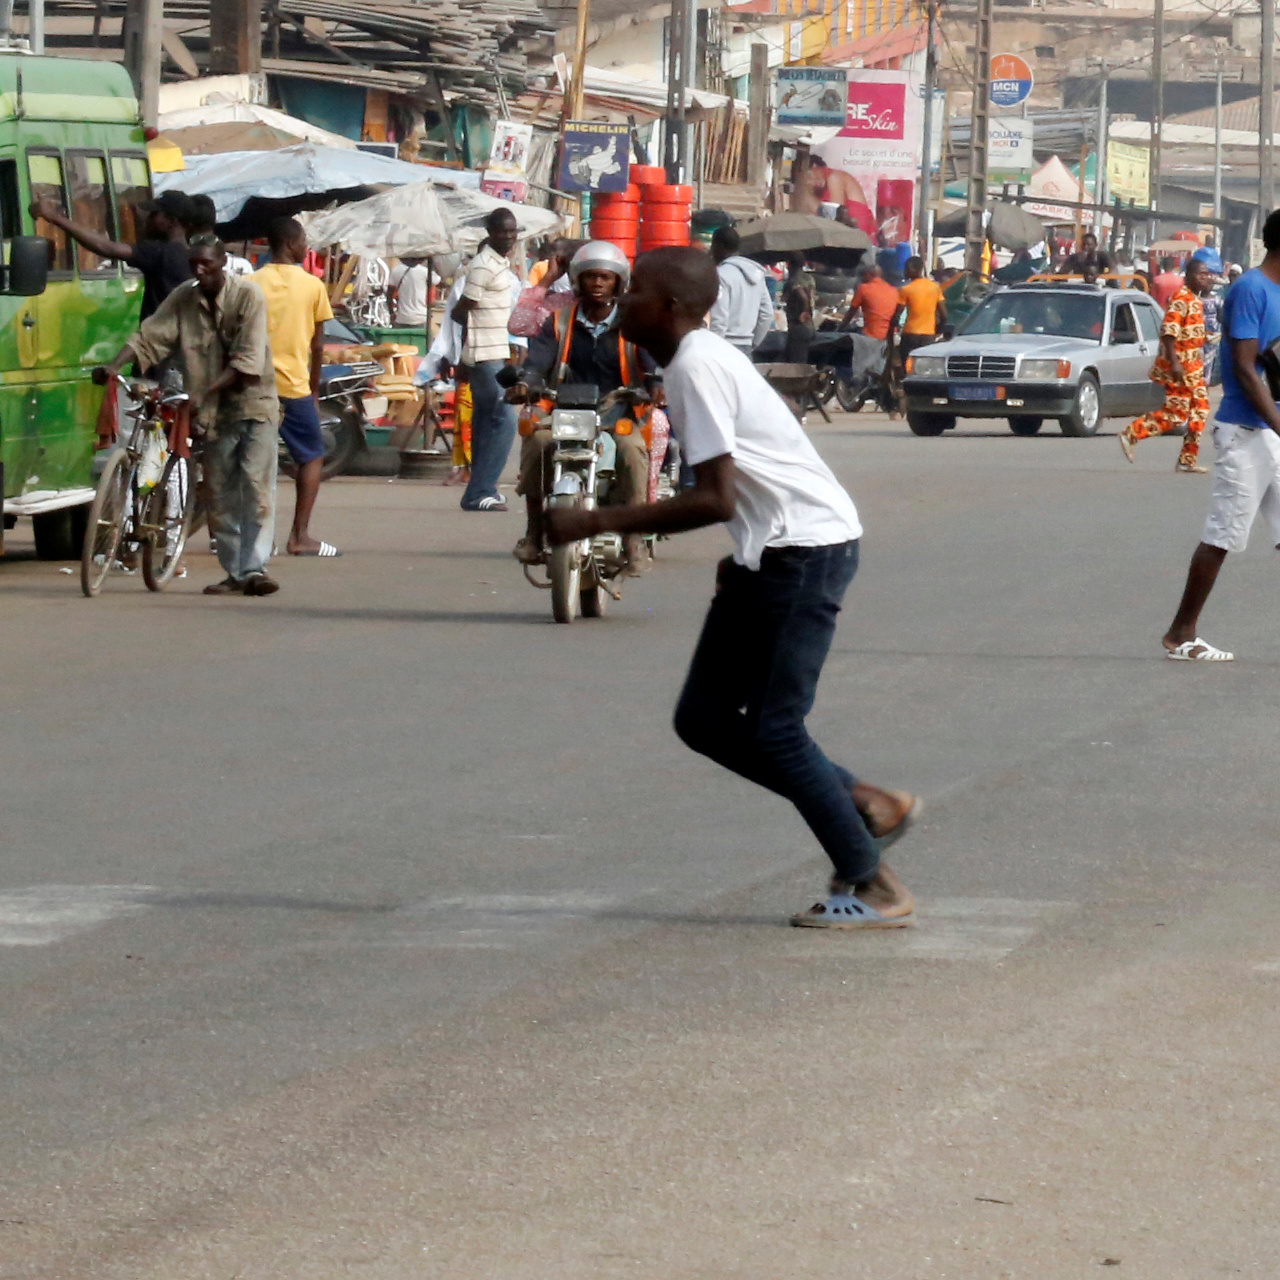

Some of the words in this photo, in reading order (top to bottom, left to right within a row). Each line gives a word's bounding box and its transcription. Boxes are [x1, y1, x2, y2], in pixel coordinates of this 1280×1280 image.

[993, 82, 1020, 92] MCN
[862, 109, 898, 132] Skin
[565, 123, 629, 134] MICHELIN
